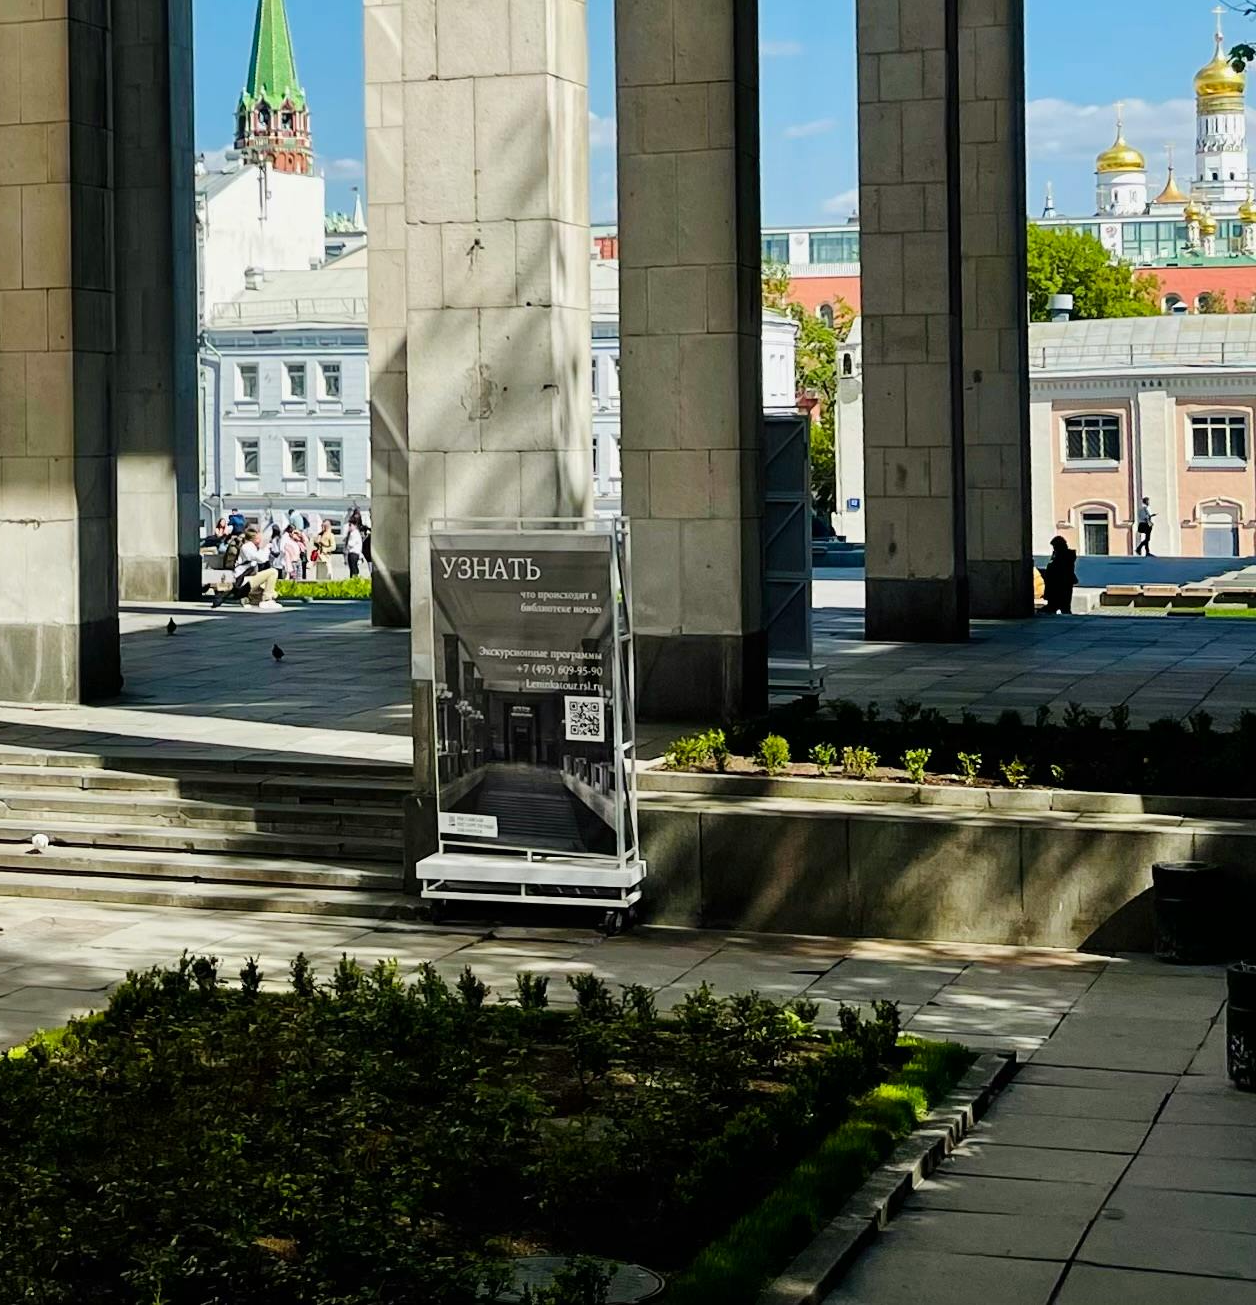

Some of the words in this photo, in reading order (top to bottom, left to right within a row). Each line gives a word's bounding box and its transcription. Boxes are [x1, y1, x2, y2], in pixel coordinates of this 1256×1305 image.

[440, 557, 541, 581] УЗНАТЬ
[550, 650, 603, 662] программы
[517, 663, 530, 673] +7
[532, 664, 555, 676] (495)
[557, 665, 604, 677] 609-95-90
